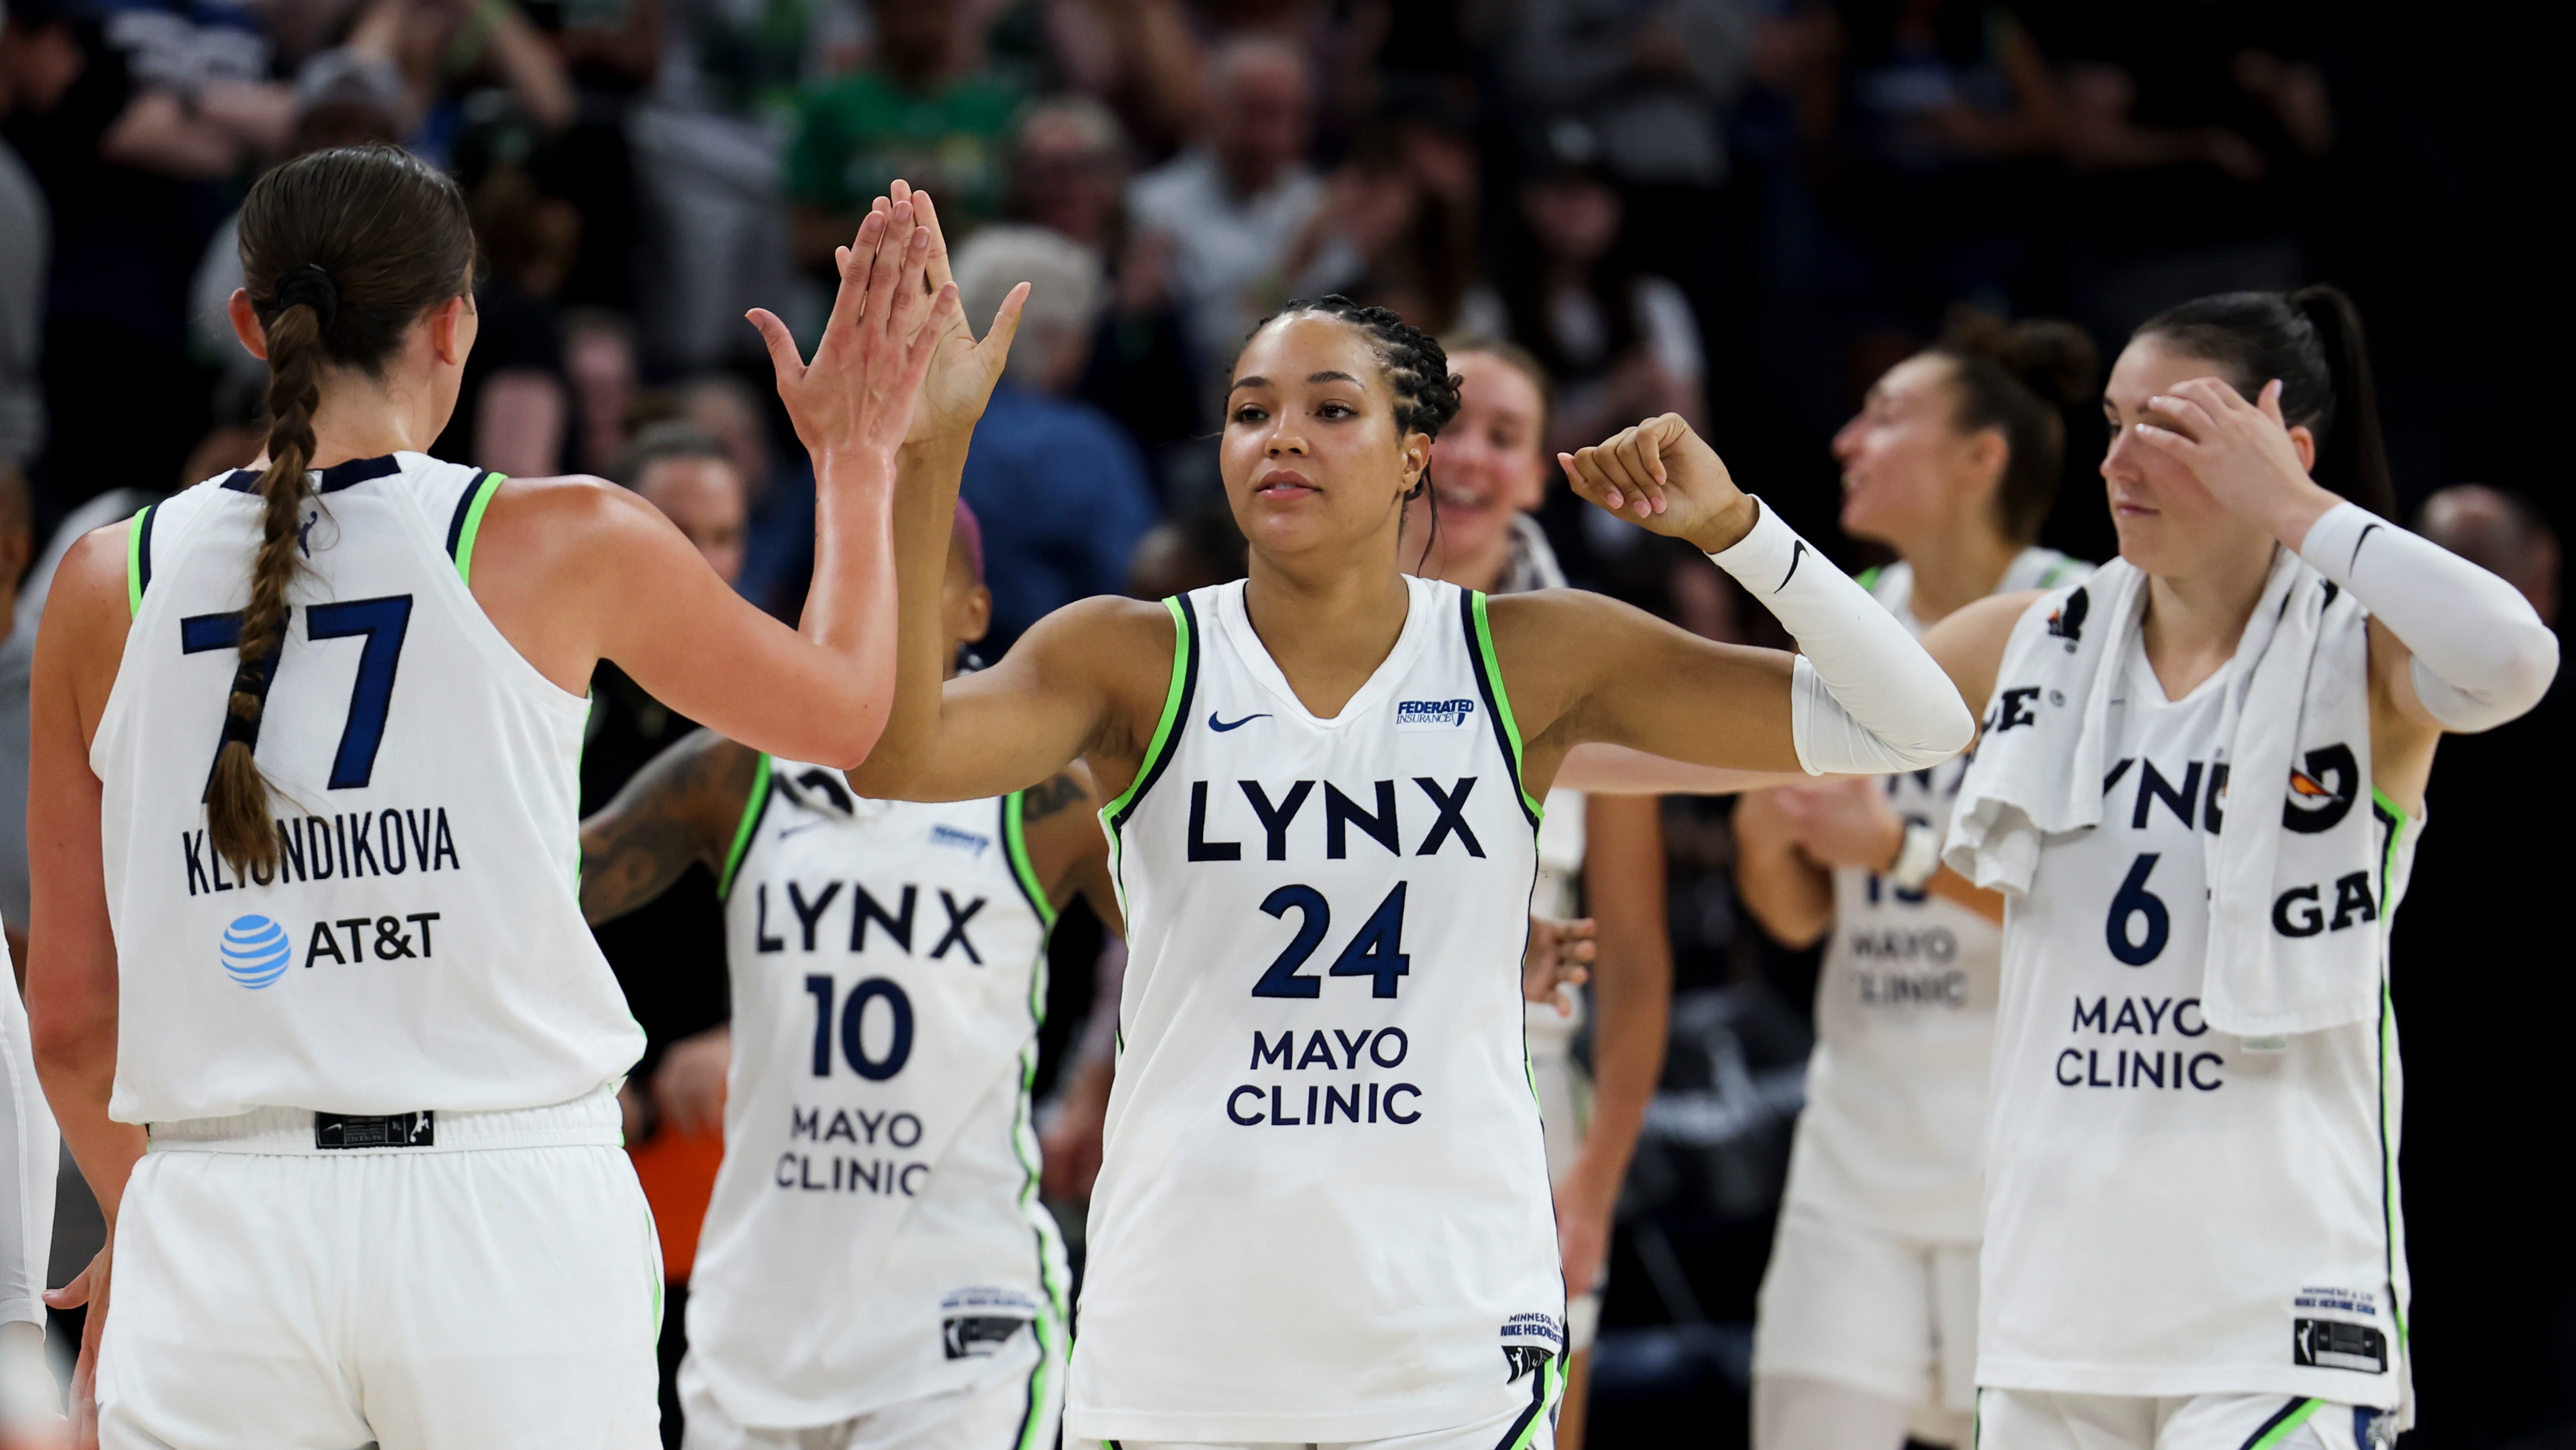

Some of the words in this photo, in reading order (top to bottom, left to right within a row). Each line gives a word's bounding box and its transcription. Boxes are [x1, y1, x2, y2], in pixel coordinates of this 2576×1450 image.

[180, 593, 414, 804] 77
[1396, 713, 1452, 725] INSURANCE
[1398, 699, 1474, 715] FEDERATED
[1187, 776, 1486, 863] LYNX
[182, 807, 460, 896] KLNDIKOVA
[756, 881, 986, 965] LYNX
[2105, 853, 2170, 967] 6
[305, 912, 441, 968] AT&T
[1251, 880, 1410, 999] 24
[805, 974, 914, 1082] 10
[2072, 995, 2209, 1037] MAYO
[1250, 1026, 1408, 1071] MAYO
[2056, 1048, 2225, 1091] CLINIC
[791, 1104, 922, 1148] MAYO
[1226, 1082, 1422, 1126] CLINIC
[777, 1153, 930, 1197] CLINIC
[1500, 1324, 1522, 1336] NIKE
